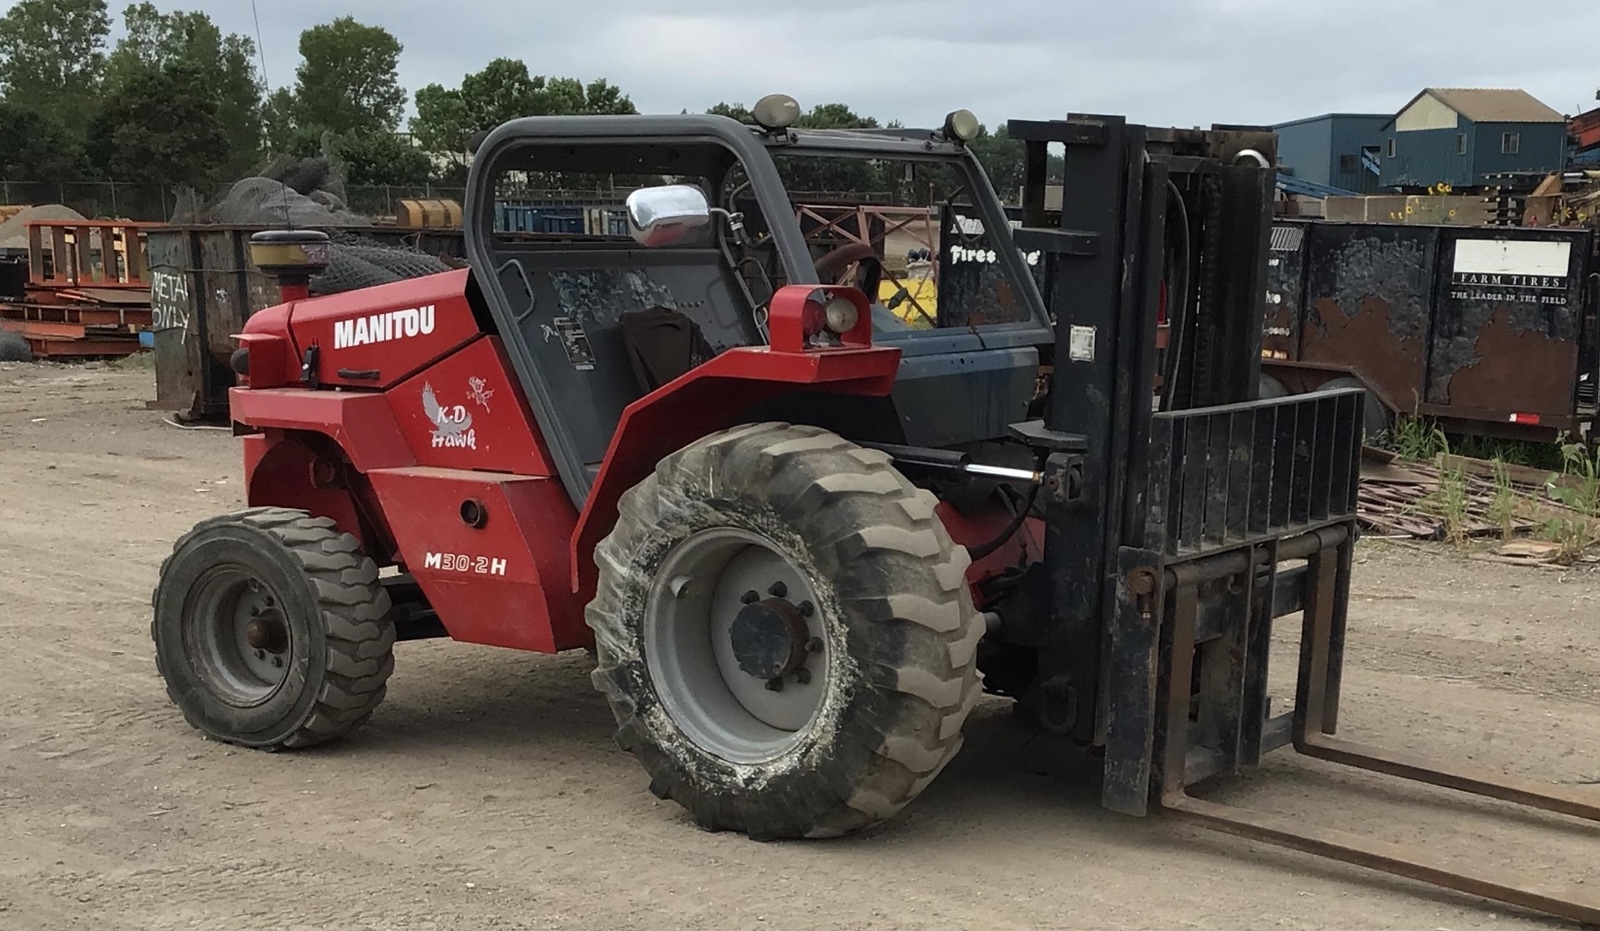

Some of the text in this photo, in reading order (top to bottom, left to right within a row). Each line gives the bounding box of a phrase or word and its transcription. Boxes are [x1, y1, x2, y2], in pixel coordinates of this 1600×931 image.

[1460, 274, 1560, 287] FARM TIRES
[1451, 291, 1567, 305] THE LEADER IN THE FIELD
[152, 304, 190, 345] ONLY
[334, 304, 435, 350] MANITOU
[431, 428, 477, 451] Hawk
